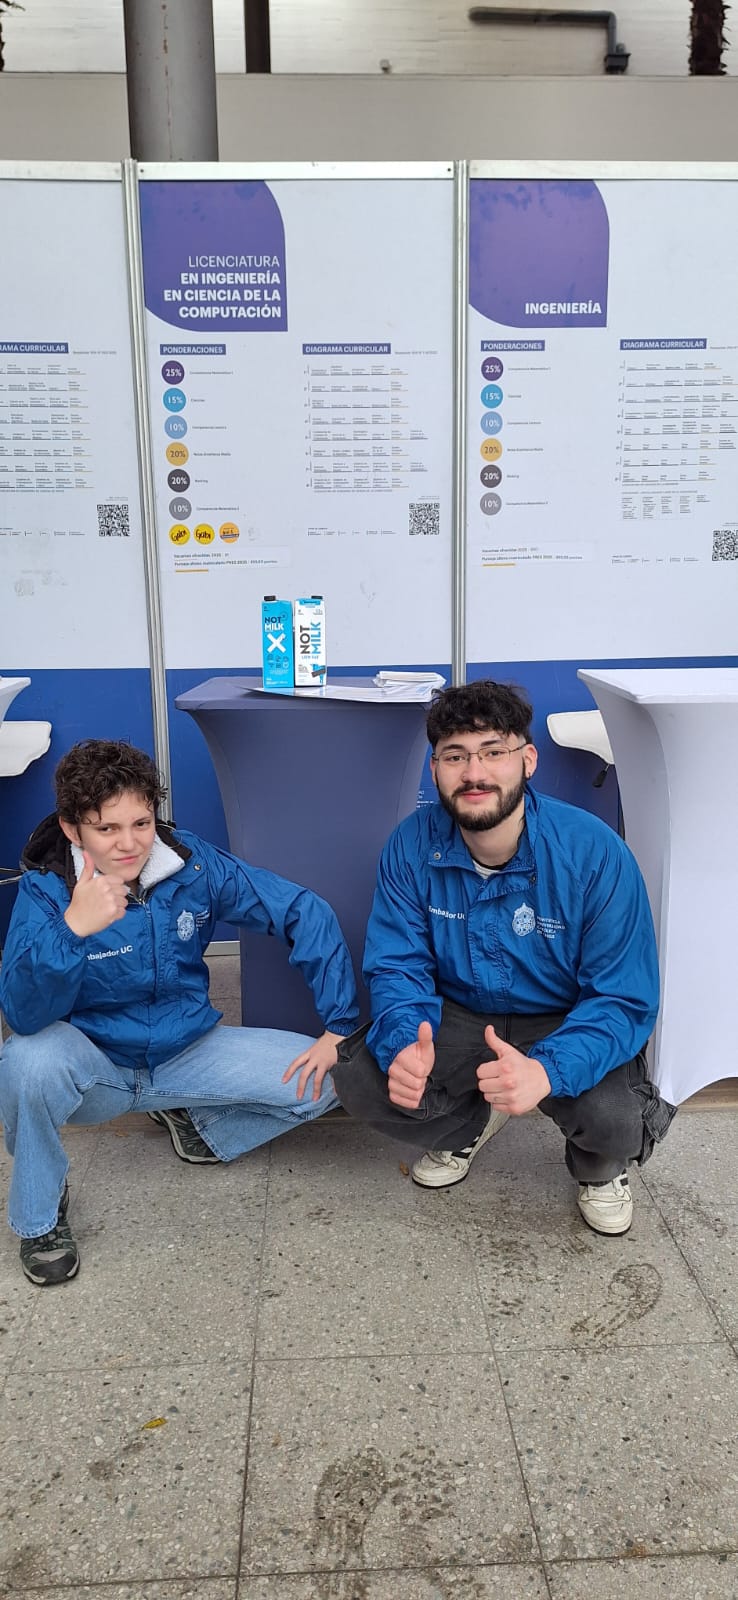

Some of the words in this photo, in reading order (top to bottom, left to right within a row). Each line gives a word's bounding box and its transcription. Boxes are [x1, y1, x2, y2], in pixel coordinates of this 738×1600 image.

[188, 255, 280, 268] LICENCIATURA
[180, 272, 199, 285] EN
[201, 270, 281, 285] INGENIERÍA
[164, 289, 182, 302] EN
[184, 289, 241, 302] CIENCIA
[243, 289, 262, 301] DE
[263, 289, 281, 301] LA
[178, 303, 281, 318] COMPUTACIÓN
[525, 300, 602, 315] INGENIERÍA
[20, 344, 66, 352] CURRICULAR
[305, 345, 343, 353] DIAGRAMA
[344, 344, 388, 353] CURRICULAR
[483, 342, 542, 350] PONDERACIONES
[623, 341, 660, 349] DIAGRAMA
[660, 340, 704, 348] CURRICULAR
[162, 346, 223, 354] PONDERACIONES
[165, 368, 182, 377] 25%
[485, 365, 501, 373] 25%
[168, 396, 183, 404] 15%
[485, 392, 500, 401] 15%
[169, 423, 185, 432] 10%
[485, 419, 500, 428] 10%
[170, 450, 186, 458] 20%
[484, 446, 499, 454] 20%
[171, 476, 188, 485] 20%
[484, 472, 500, 480] 20%
[484, 500, 499, 508] 10%
[173, 505, 189, 513] 10%
[264, 616, 281, 624] NOT
[264, 623, 284, 631] MILK
[300, 625, 311, 654] NOT
[310, 621, 321, 654] MILK
[120, 945, 133, 954] UC
